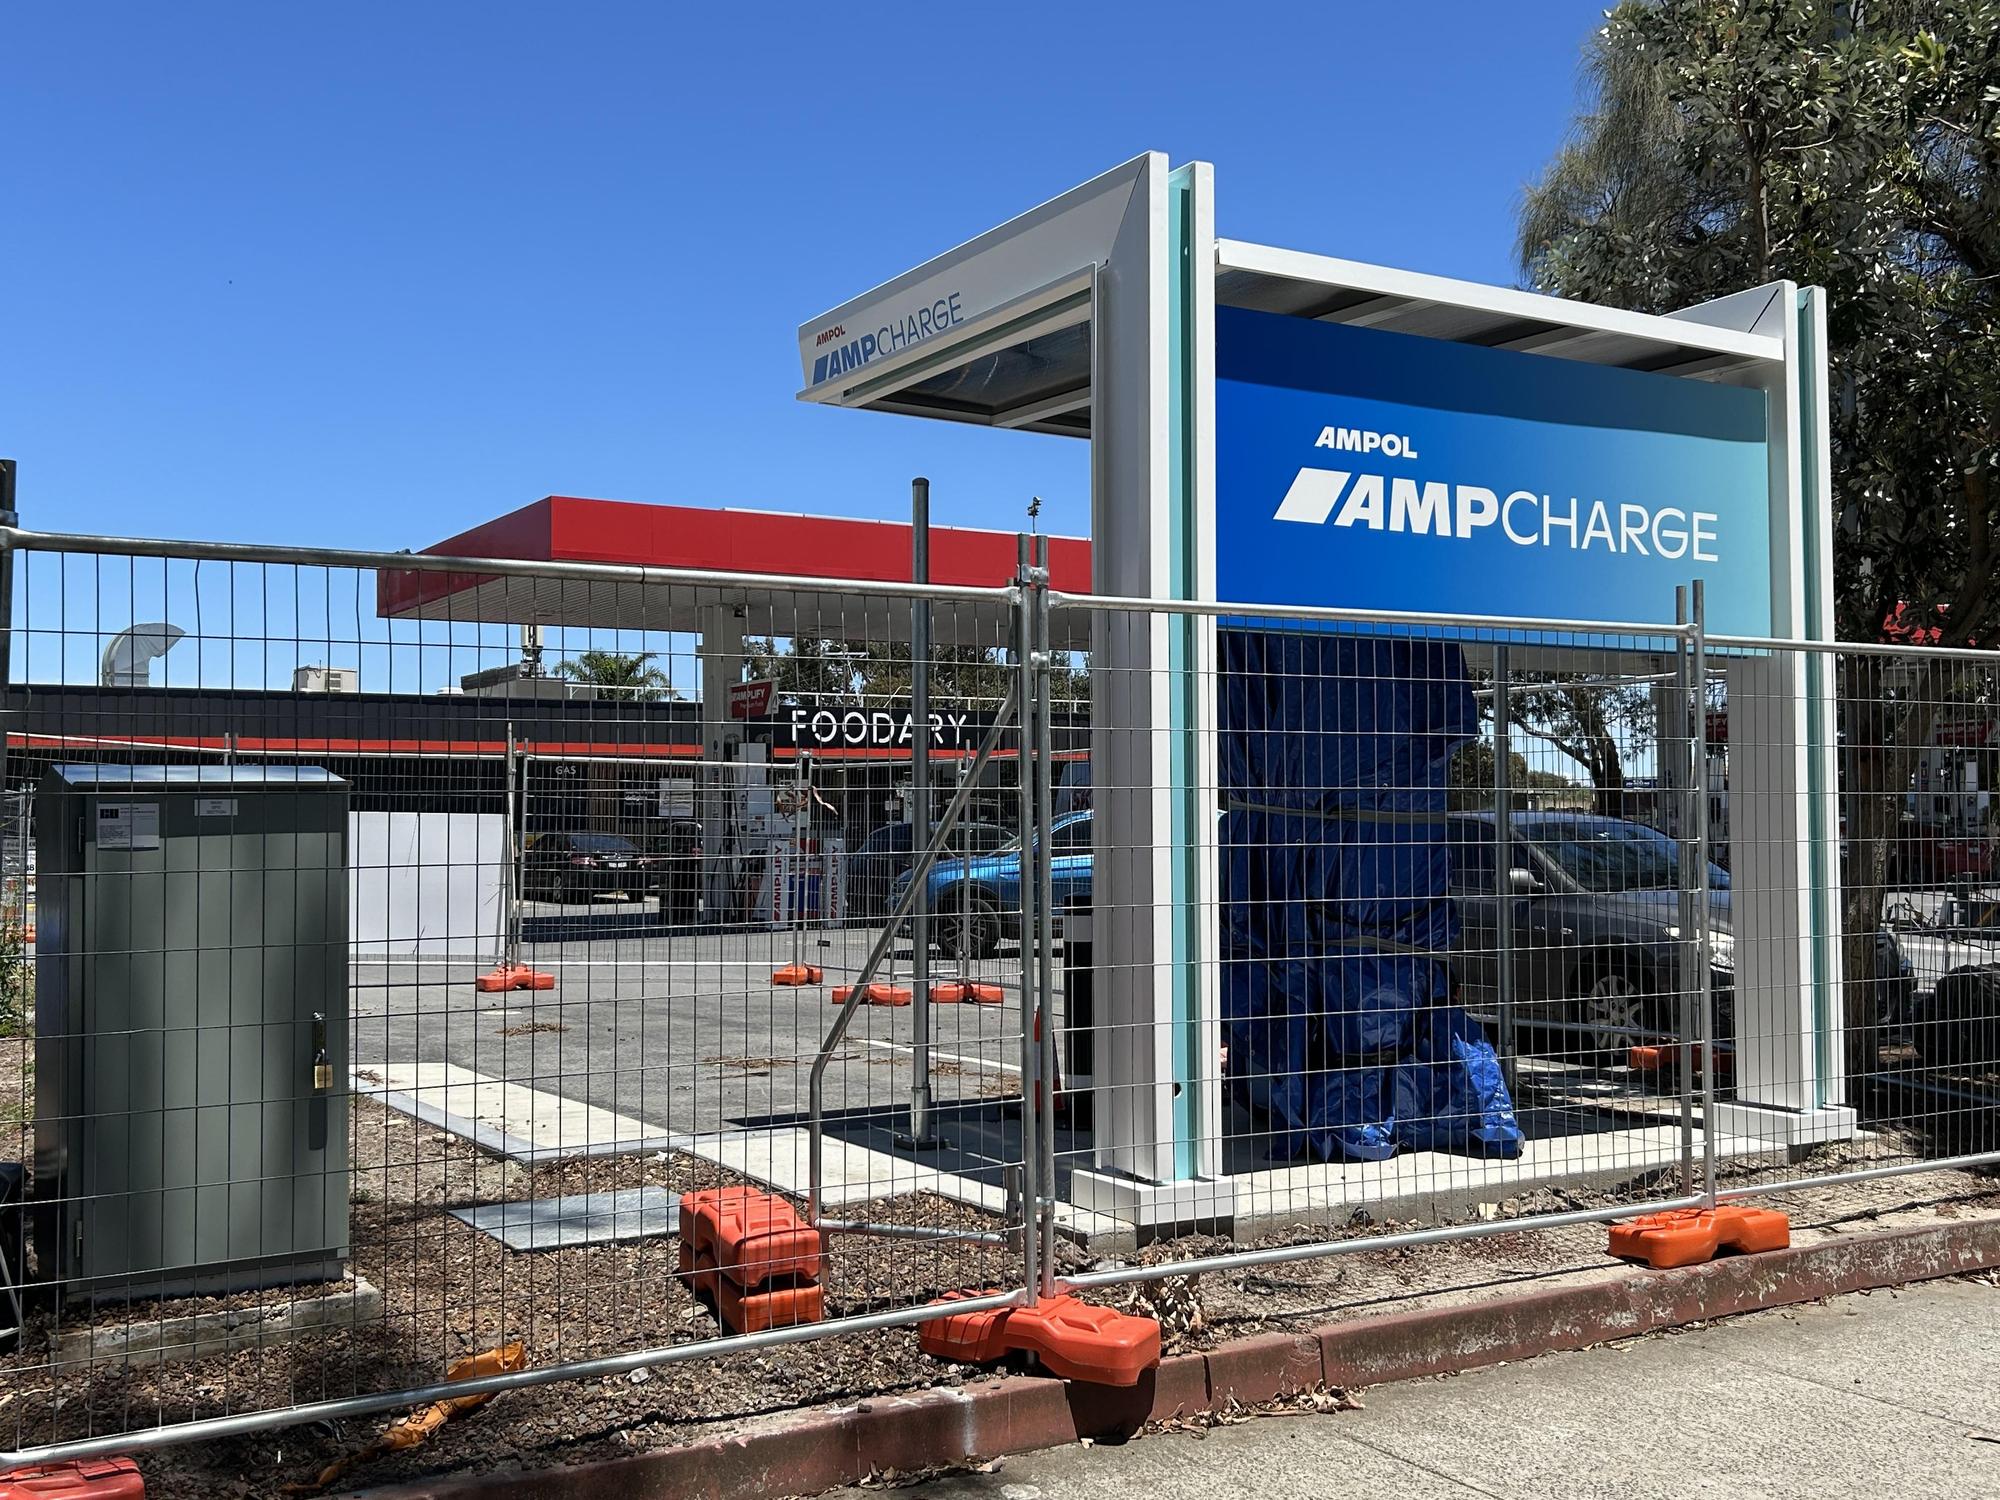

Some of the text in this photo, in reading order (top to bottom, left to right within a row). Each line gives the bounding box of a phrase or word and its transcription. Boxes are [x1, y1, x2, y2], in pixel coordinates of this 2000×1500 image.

[816, 325, 846, 347] AMPOL
[828, 292, 964, 379] AMPCHARGE
[1314, 426, 1418, 459] AMPOL
[1334, 474, 1719, 562] AMPCHARGE
[792, 710, 967, 744] FOODARY
[555, 766, 577, 775] GAS
